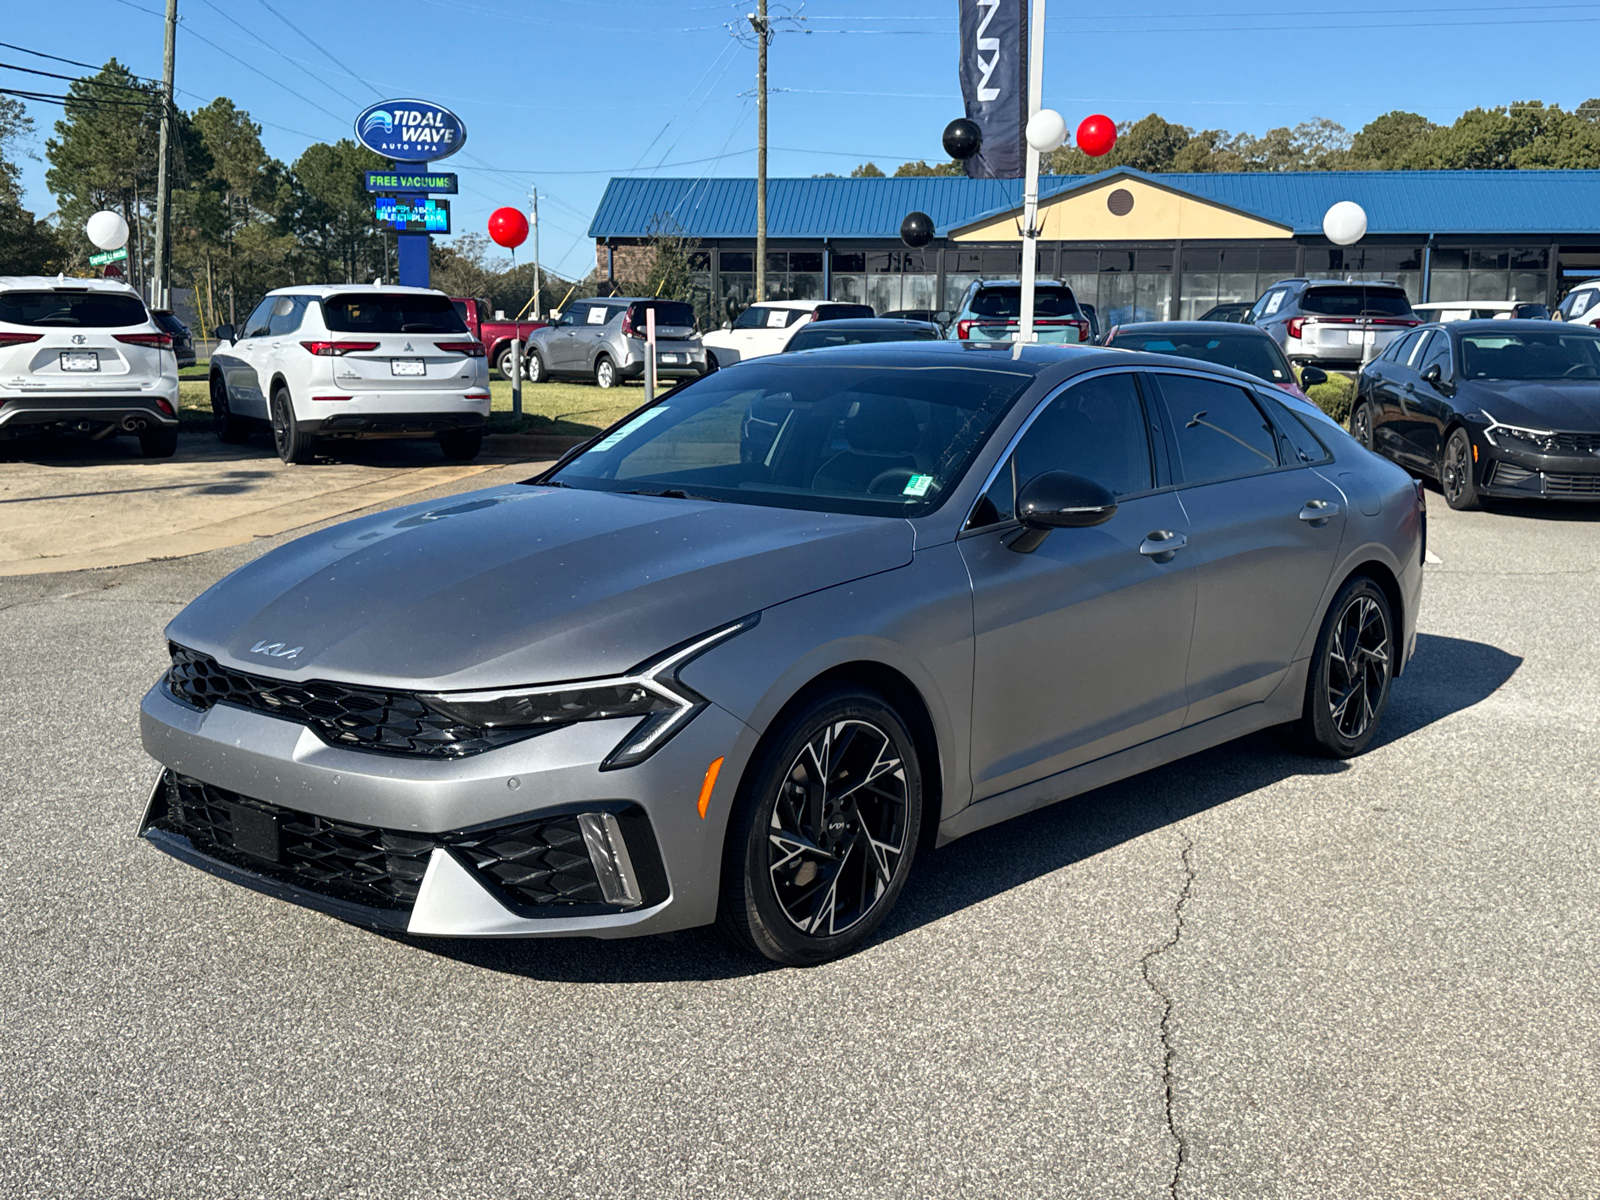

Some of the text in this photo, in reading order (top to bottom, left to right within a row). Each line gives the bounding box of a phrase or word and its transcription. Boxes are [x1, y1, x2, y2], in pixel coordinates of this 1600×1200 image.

[394, 111, 444, 127] TIDAL
[402, 127, 454, 143] WAVE
[382, 142, 437, 151] AUTO SPA
[370, 175, 451, 188] FREE VACUUMS
